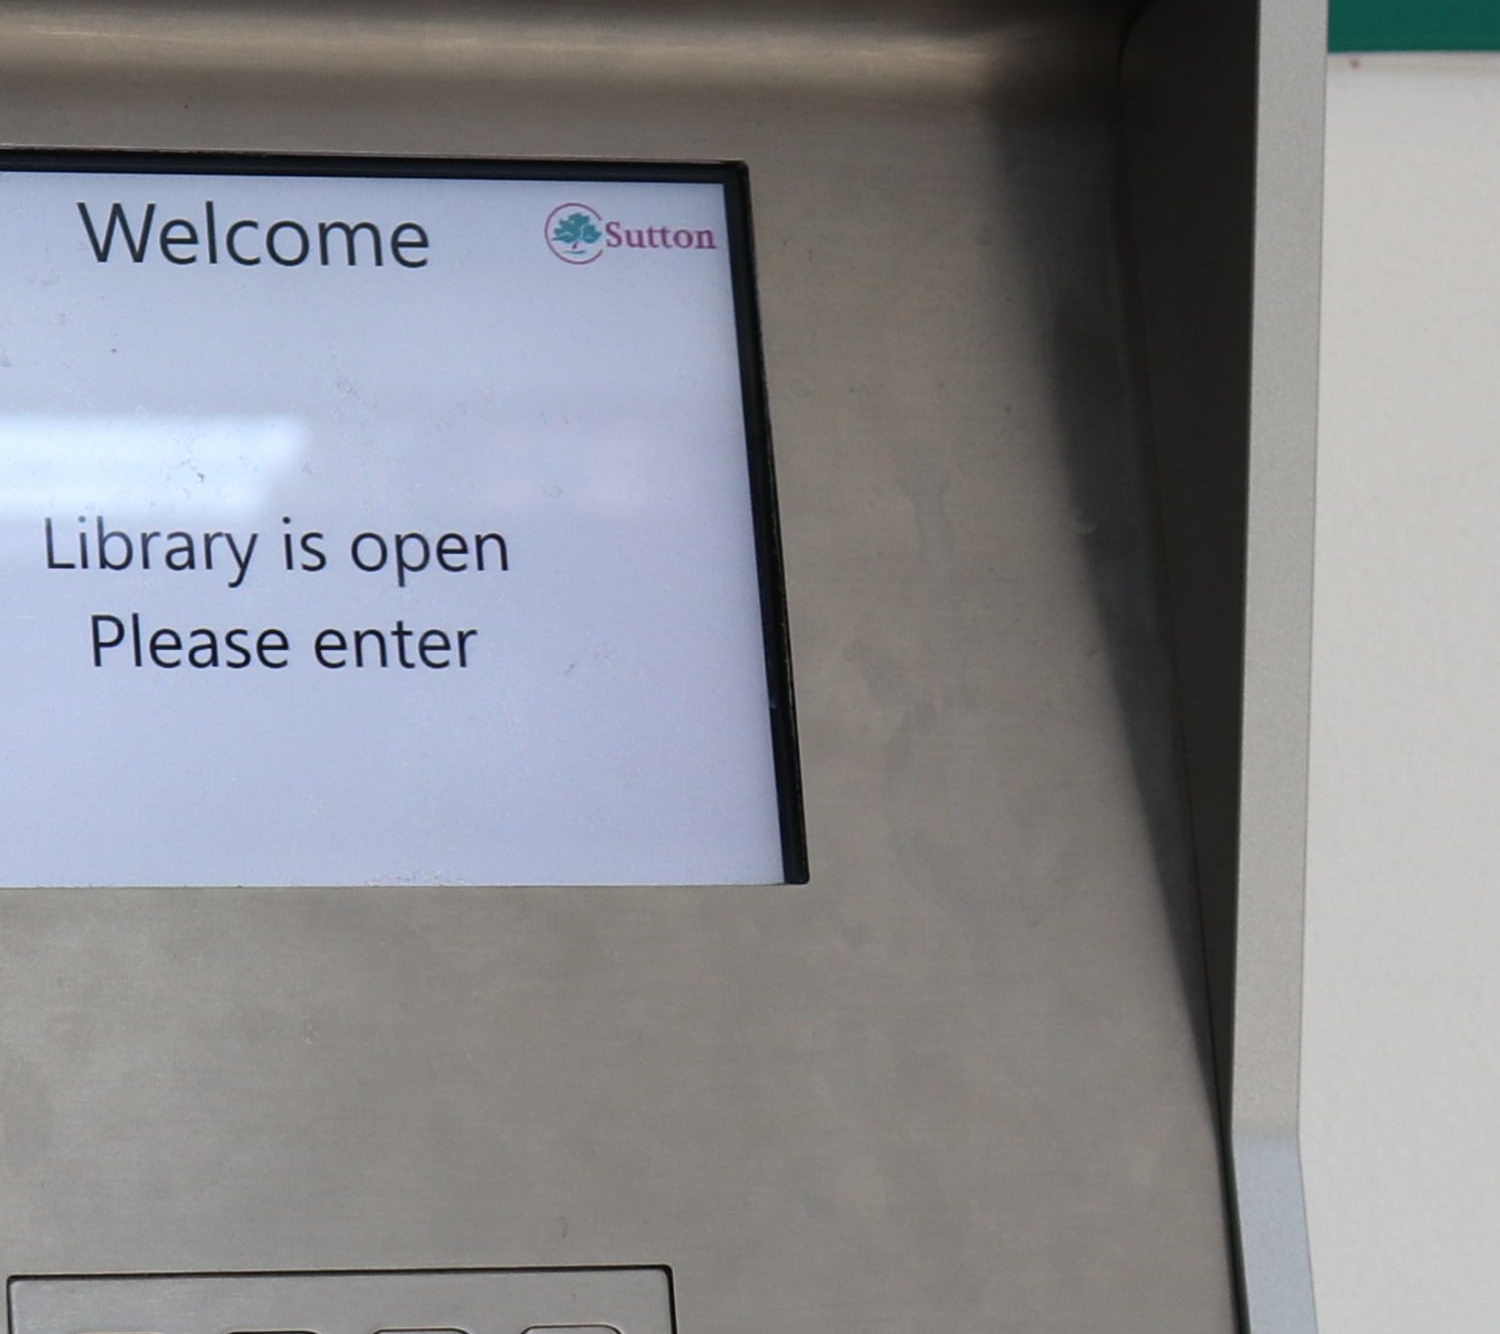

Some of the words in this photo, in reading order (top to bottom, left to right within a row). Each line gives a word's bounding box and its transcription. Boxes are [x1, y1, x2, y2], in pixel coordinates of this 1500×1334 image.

[77, 201, 429, 268] Welcome
[605, 221, 718, 250] Sutton
[46, 517, 258, 588] Library
[283, 517, 326, 571] is
[352, 533, 508, 587] open
[92, 613, 289, 668] Please
[315, 621, 477, 668] enter
